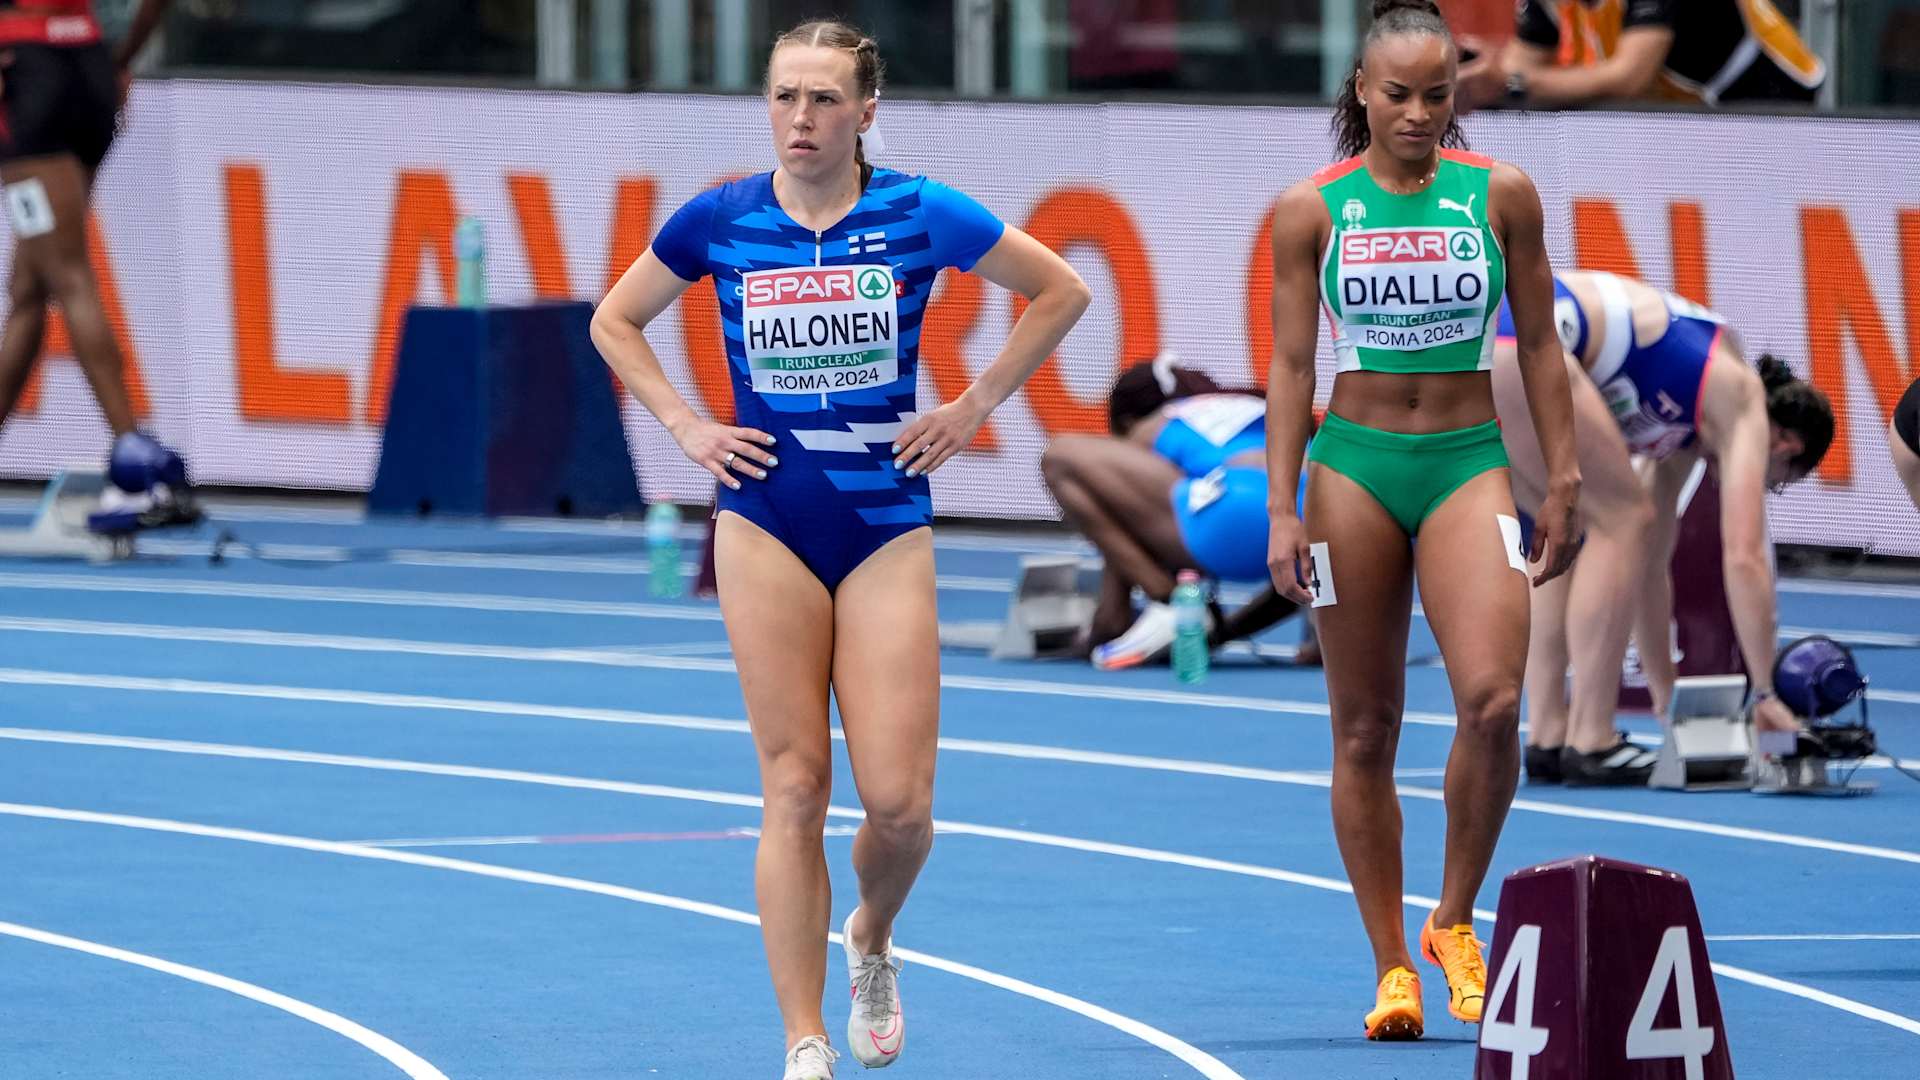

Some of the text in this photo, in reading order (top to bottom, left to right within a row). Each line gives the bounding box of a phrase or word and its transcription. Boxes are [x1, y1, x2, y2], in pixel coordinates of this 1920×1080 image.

[1344, 235, 1446, 261] SPAR
[749, 273, 852, 303] SPAR
[1343, 272, 1482, 306] DIALLO
[749, 311, 890, 350] HALONEN
[1379, 314, 1407, 326] RUN
[1366, 323, 1464, 347] ROMA 2024
[786, 357, 815, 369] RUN
[772, 367, 880, 390] ROMA 2024
[1480, 924, 1550, 1080] 4
[1626, 925, 1715, 1080] 4
